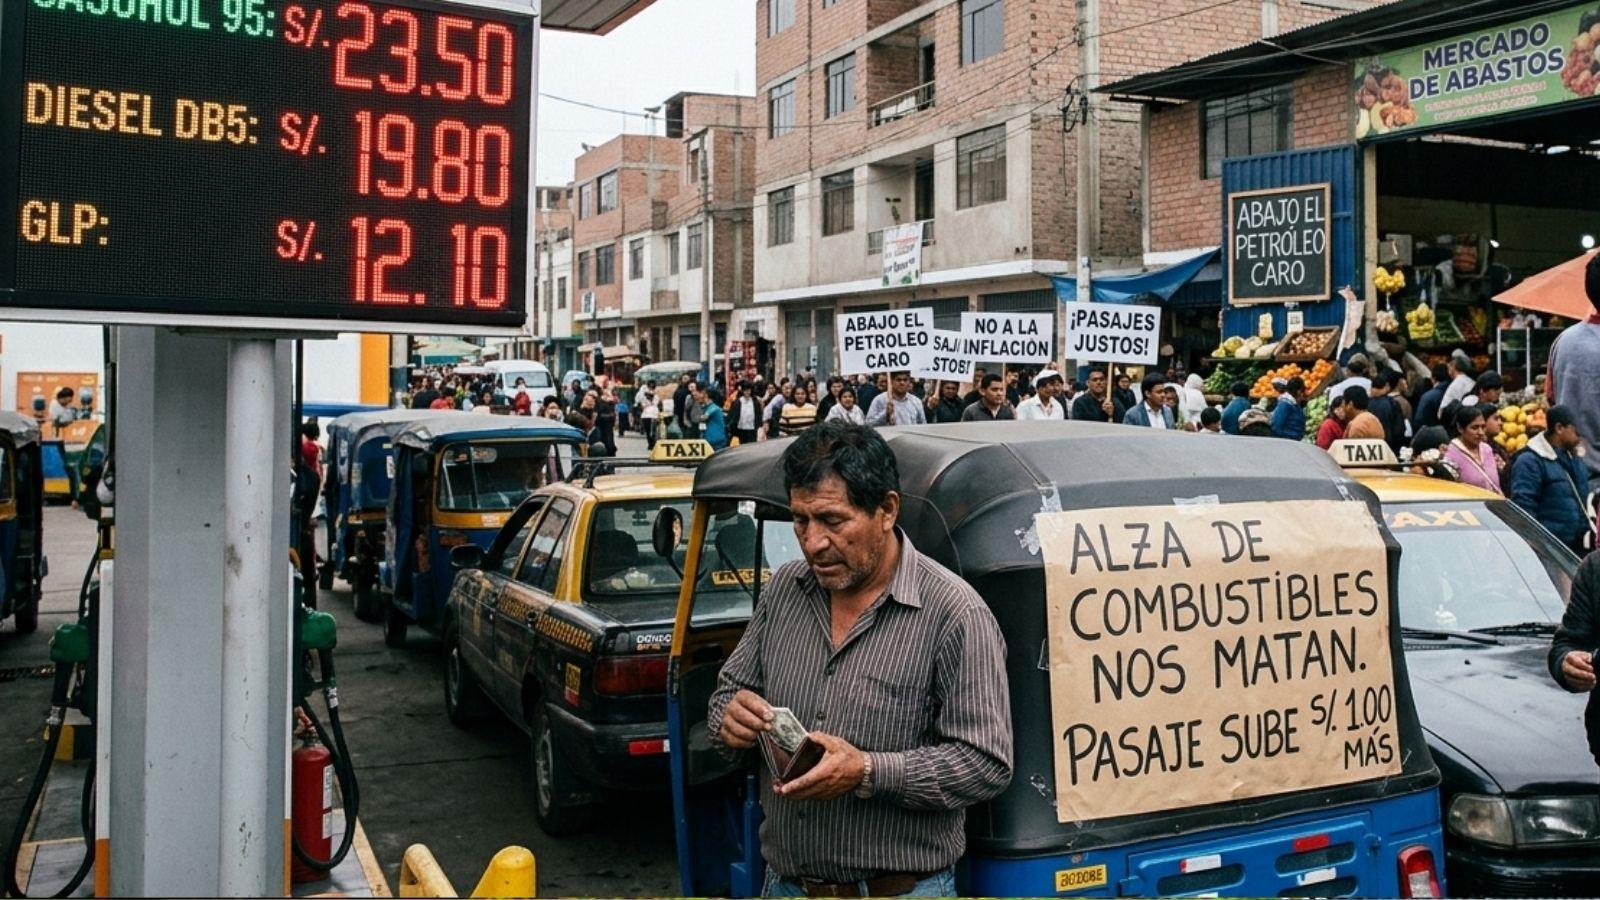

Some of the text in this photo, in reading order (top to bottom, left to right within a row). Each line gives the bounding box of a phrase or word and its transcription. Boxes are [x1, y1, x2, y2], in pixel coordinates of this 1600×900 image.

[222, 0, 274, 37] 95:
[284, 6, 329, 47] S/.
[334, 2, 514, 104] 23.50
[1423, 23, 1550, 71] MERCADO
[1409, 74, 1440, 99] DE
[1445, 48, 1564, 92] ABASTOS
[26, 82, 511, 206] DIESEL DB5: S/. 19.80
[1236, 195, 1325, 230] ABAJO EL
[21, 200, 108, 244] GLP:
[277, 220, 323, 261] S/.
[1236, 226, 1326, 260] PETRÓLEO
[1250, 260, 1305, 287] CARO
[845, 312, 924, 333] ABAJO EL
[975, 318, 1039, 336] NO A LA
[1070, 308, 1155, 332] ¡PASAJES
[844, 330, 929, 352] PETROLEO
[1074, 334, 1149, 357] JUSTOS!
[866, 352, 910, 369] CARO
[661, 442, 705, 458] TAXI
[1344, 444, 1383, 462] TAXI
[1383, 510, 1481, 529] AXI
[1070, 519, 1270, 575] ALZA DE
[1092, 626, 1367, 704] NOS MATAN.
[1063, 684, 1391, 786] PASAJE SUBE S/. 1.00
[1344, 726, 1394, 770] MÁS
